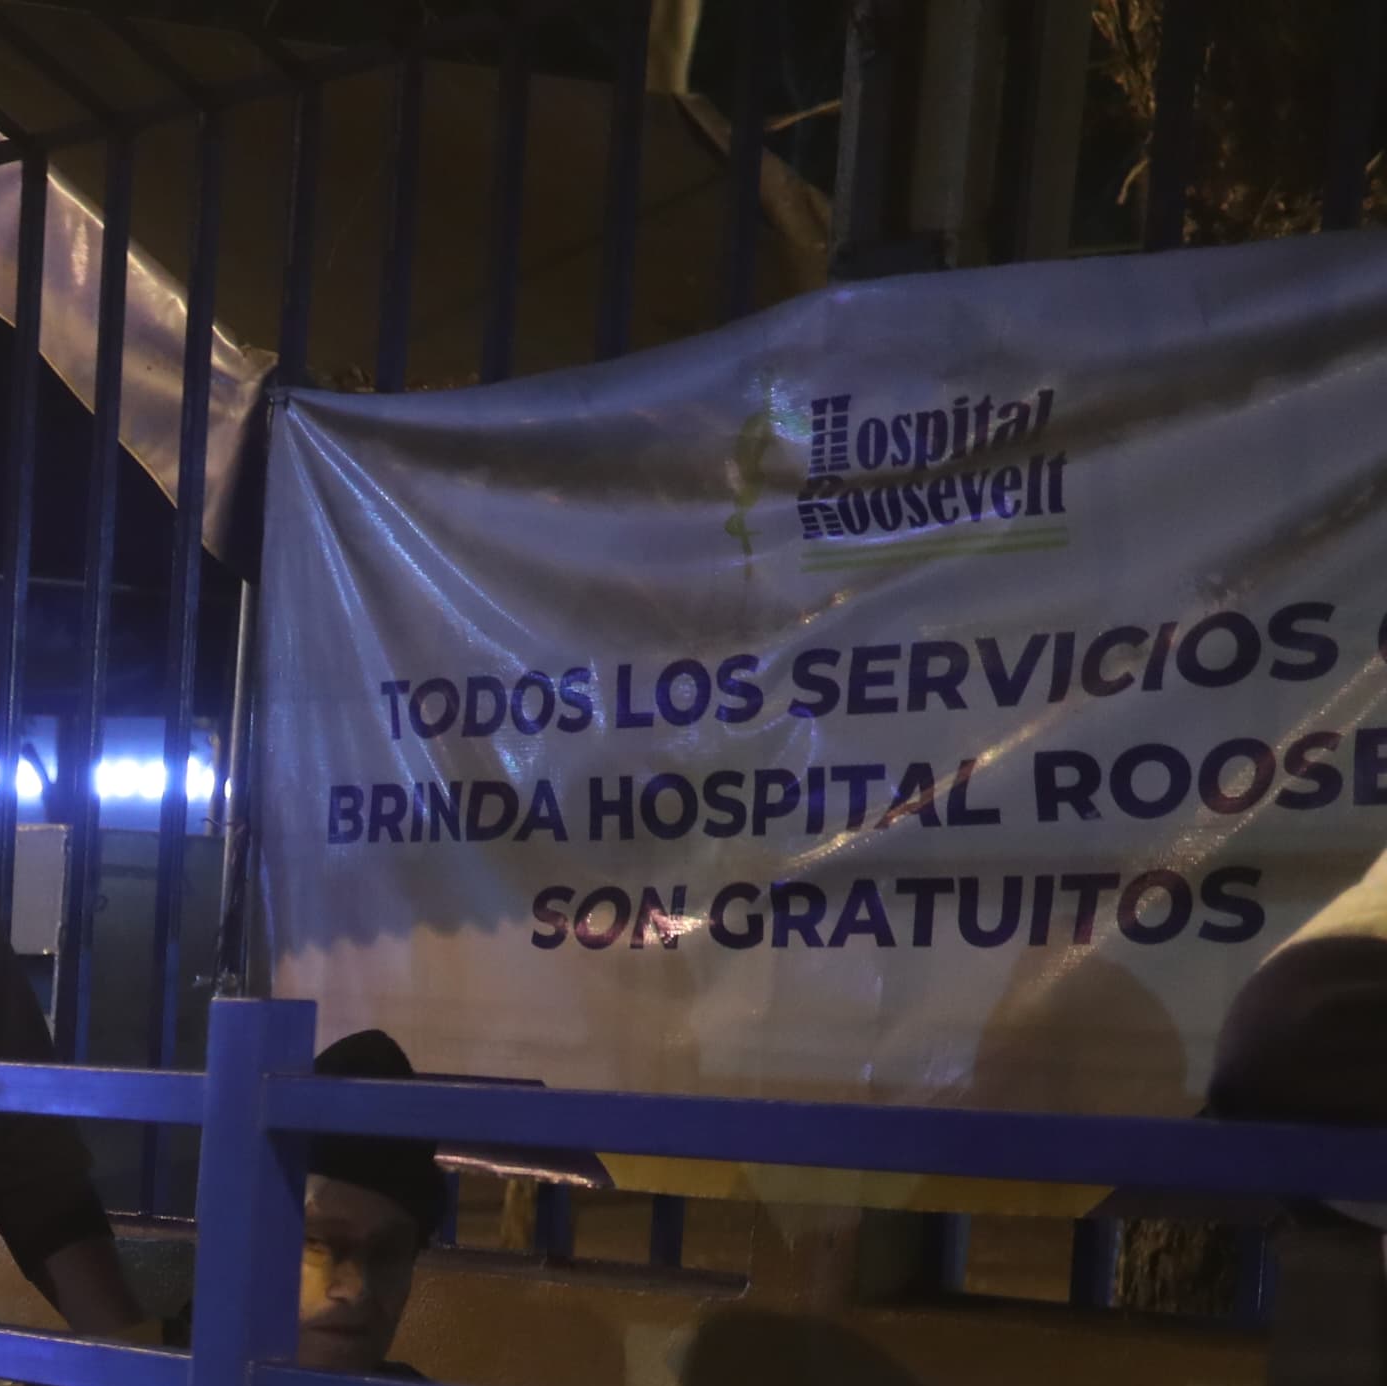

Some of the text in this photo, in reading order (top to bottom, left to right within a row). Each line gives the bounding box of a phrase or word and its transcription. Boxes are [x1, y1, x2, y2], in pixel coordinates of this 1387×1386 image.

[807, 388, 1055, 474] Hospital
[798, 450, 1068, 540] Roosevelt
[381, 663, 594, 741] TODOS
[615, 654, 764, 731] LOS
[787, 602, 1339, 718] SERVICIOS
[327, 780, 569, 846] BRINDA
[588, 760, 1003, 844] HOSPITAL
[531, 866, 1267, 950] SON GRATUITOS
